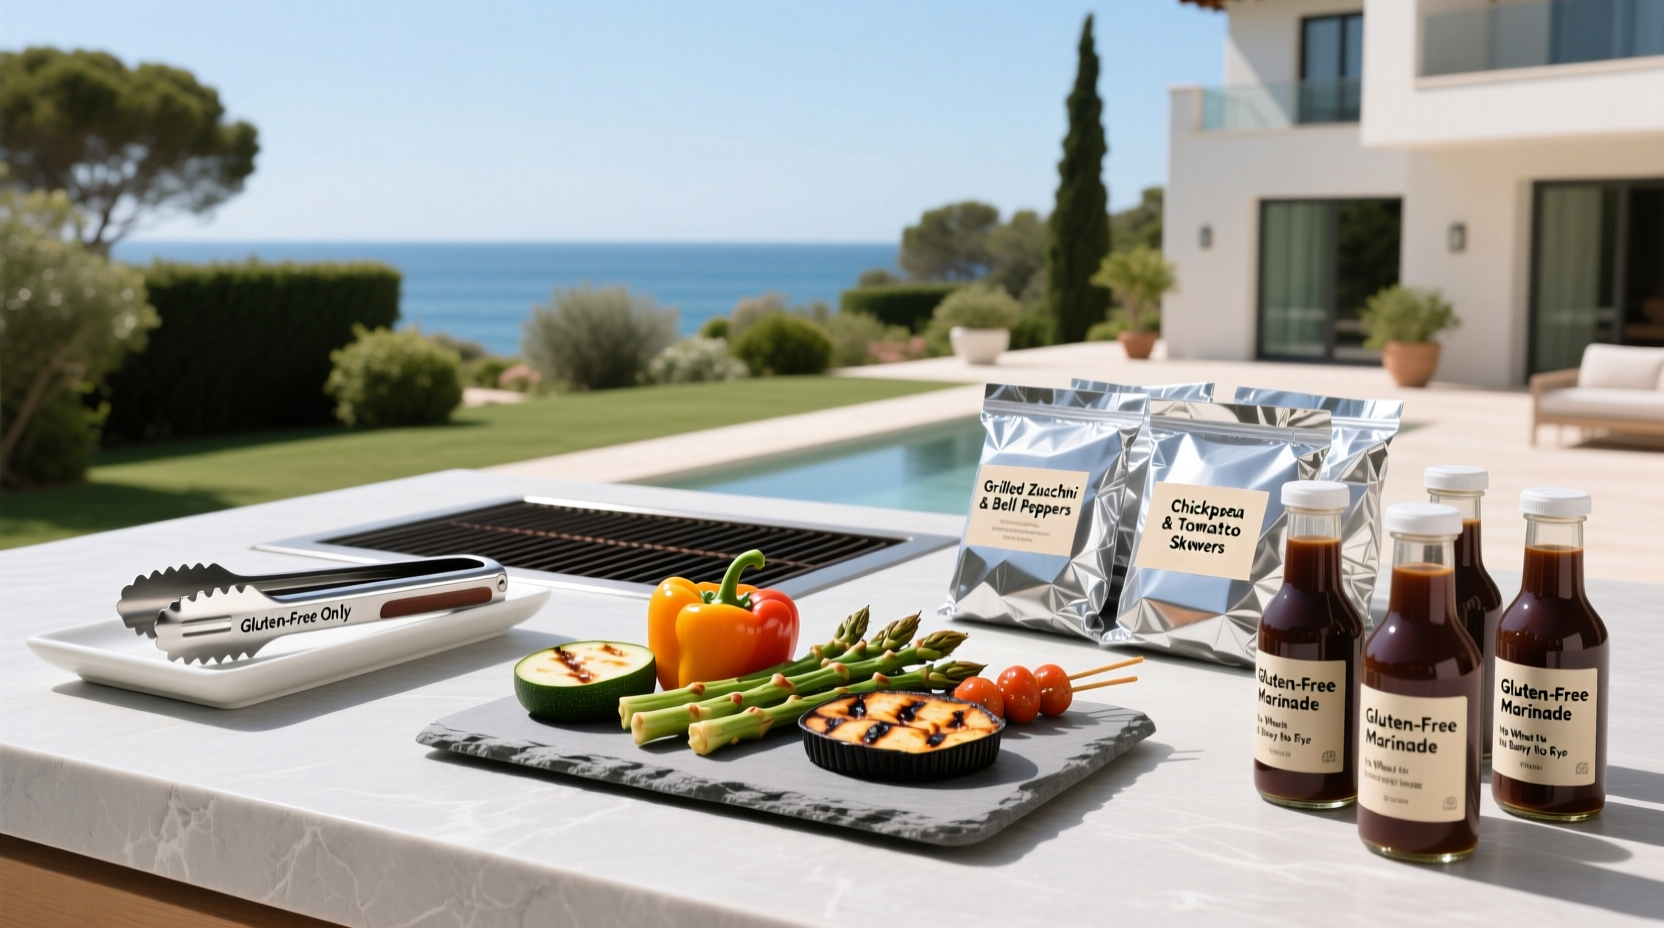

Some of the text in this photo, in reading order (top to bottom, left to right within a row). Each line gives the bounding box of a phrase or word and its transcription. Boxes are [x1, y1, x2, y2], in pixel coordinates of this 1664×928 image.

[984, 480, 1025, 496] Grilled
[979, 496, 1071, 519] & Bell Peppers
[1162, 515, 1173, 530] &
[240, 604, 352, 633] Gluten-Free Only
[1258, 667, 1337, 693] Gluten-Free
[1500, 678, 1590, 702] Gluten-Free
[1258, 687, 1320, 711] Marinade
[1500, 698, 1572, 721] Marinade
[1366, 707, 1458, 733] Gluten-Free
[1365, 727, 1438, 754] Marinade
